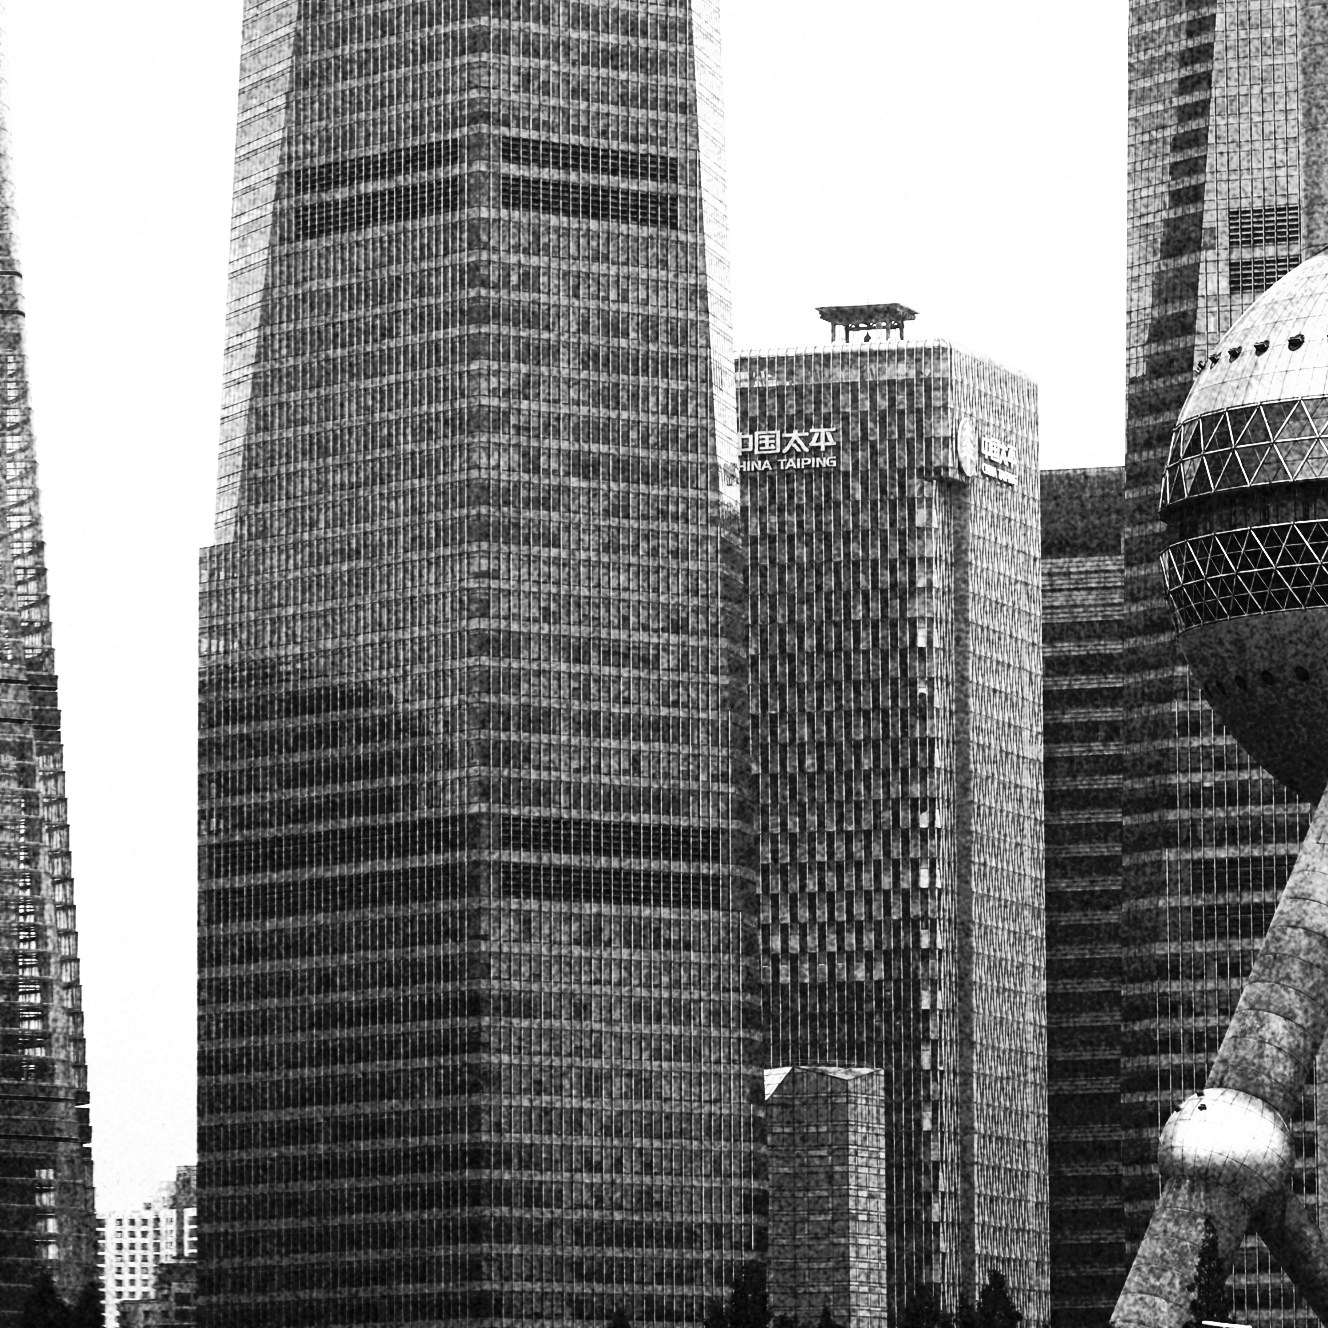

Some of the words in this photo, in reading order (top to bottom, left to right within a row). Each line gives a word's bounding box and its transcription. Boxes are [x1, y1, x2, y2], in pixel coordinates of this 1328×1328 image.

[737, 427, 837, 456] 中国太平
[737, 459, 773, 472] HINA
[777, 456, 837, 470] TAIPING
